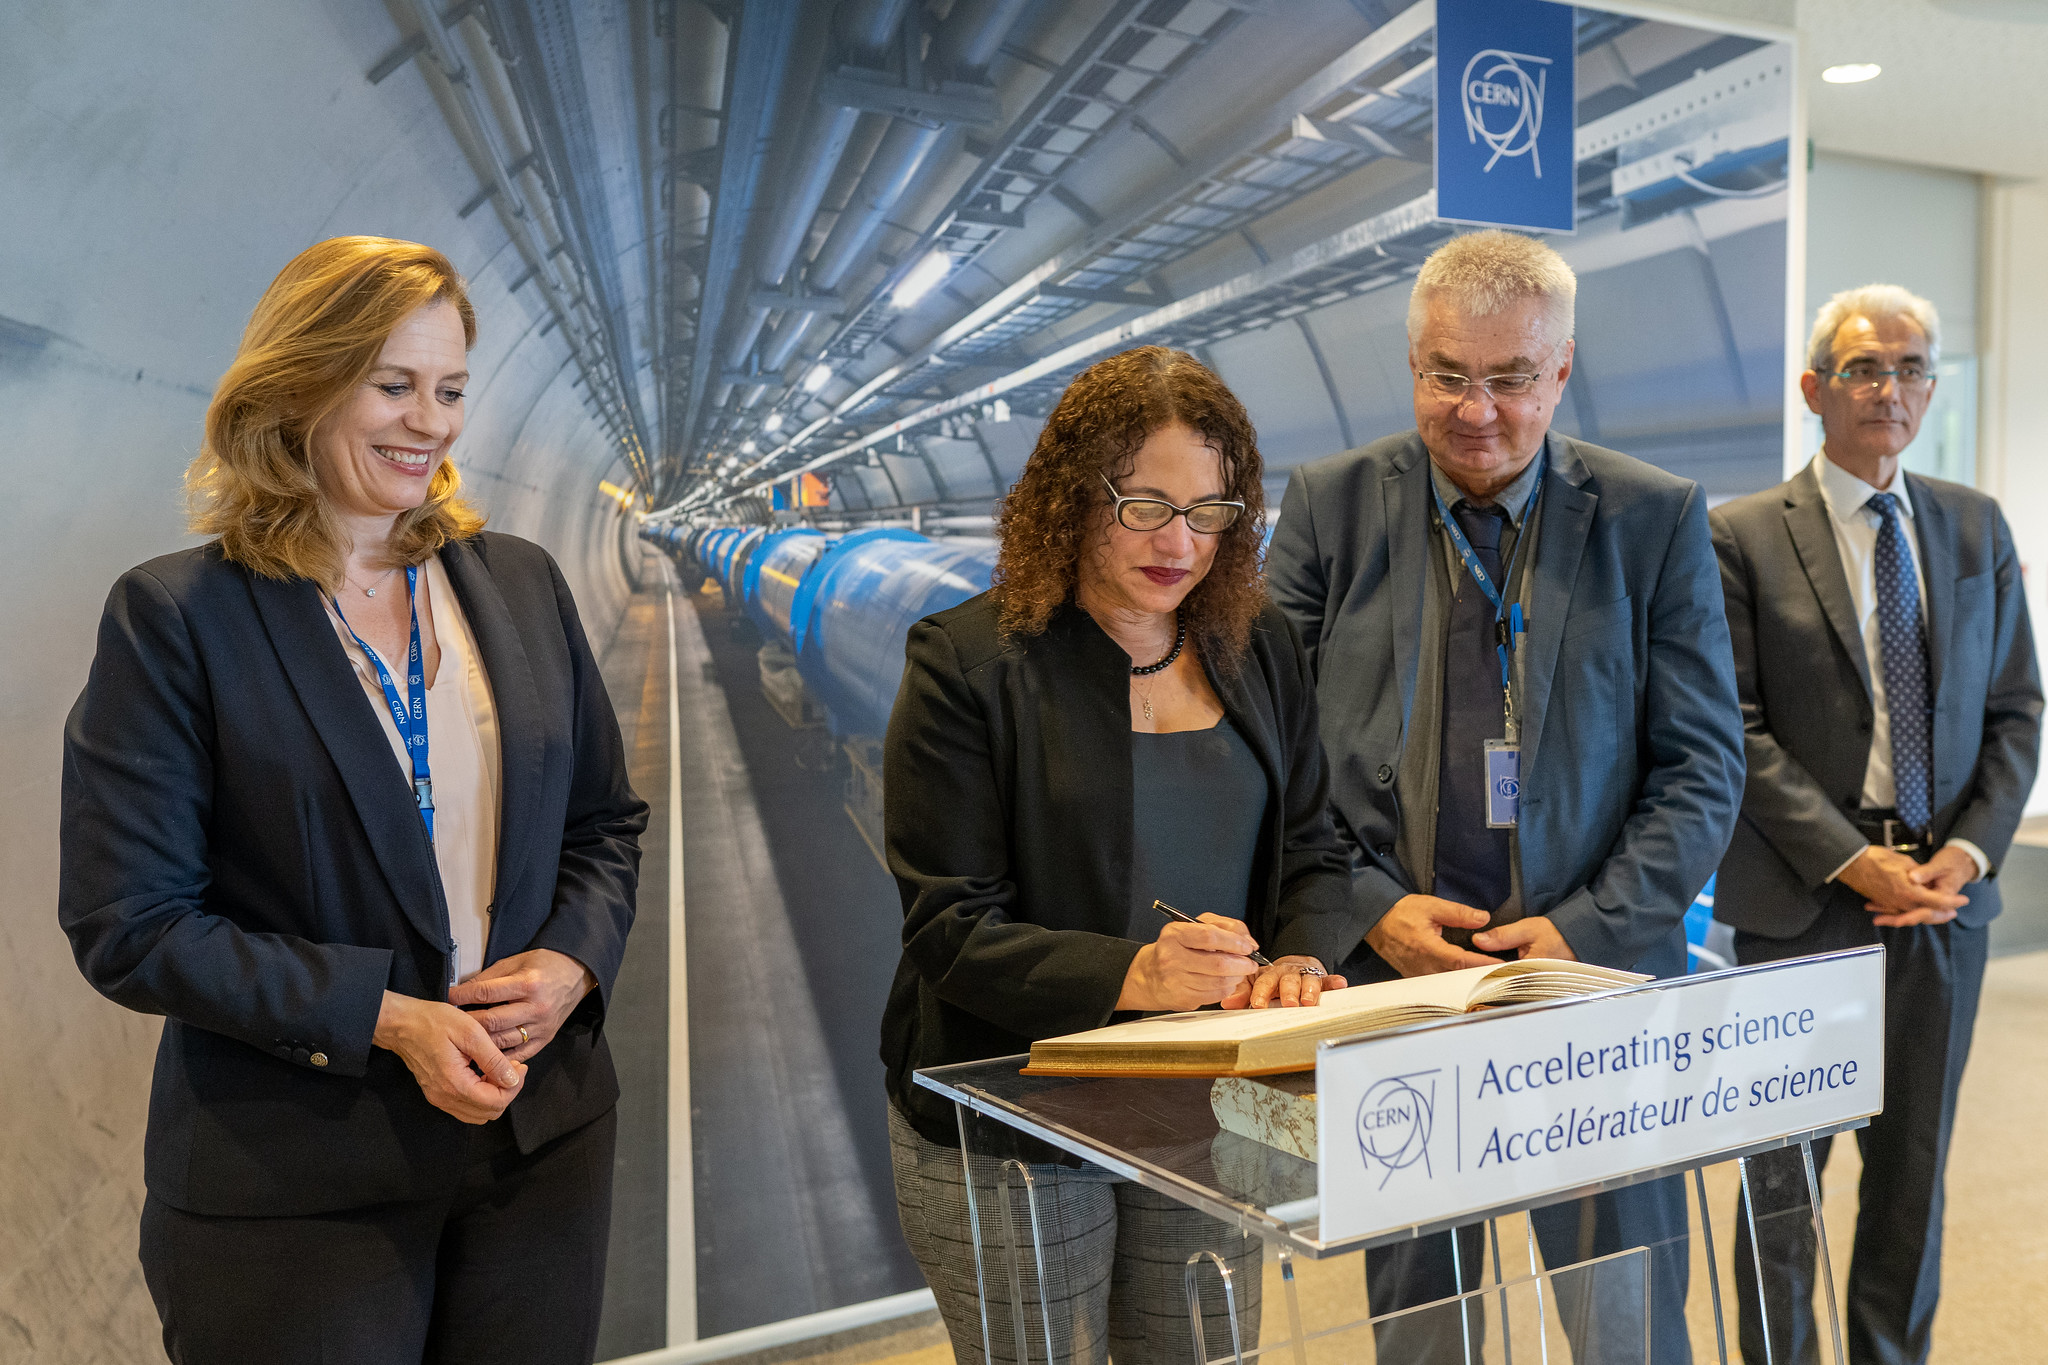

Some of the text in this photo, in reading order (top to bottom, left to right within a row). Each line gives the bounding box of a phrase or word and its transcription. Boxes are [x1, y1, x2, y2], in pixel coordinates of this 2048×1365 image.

[1469, 80, 1519, 107] CERN
[360, 642, 378, 662] CERN
[392, 700, 406, 724] CERN
[413, 697, 423, 720] CERN
[1478, 1006, 1816, 1100] Accelerating science
[1363, 1104, 1410, 1131] CERN
[1478, 1056, 1858, 1169] Accélérateur de science
